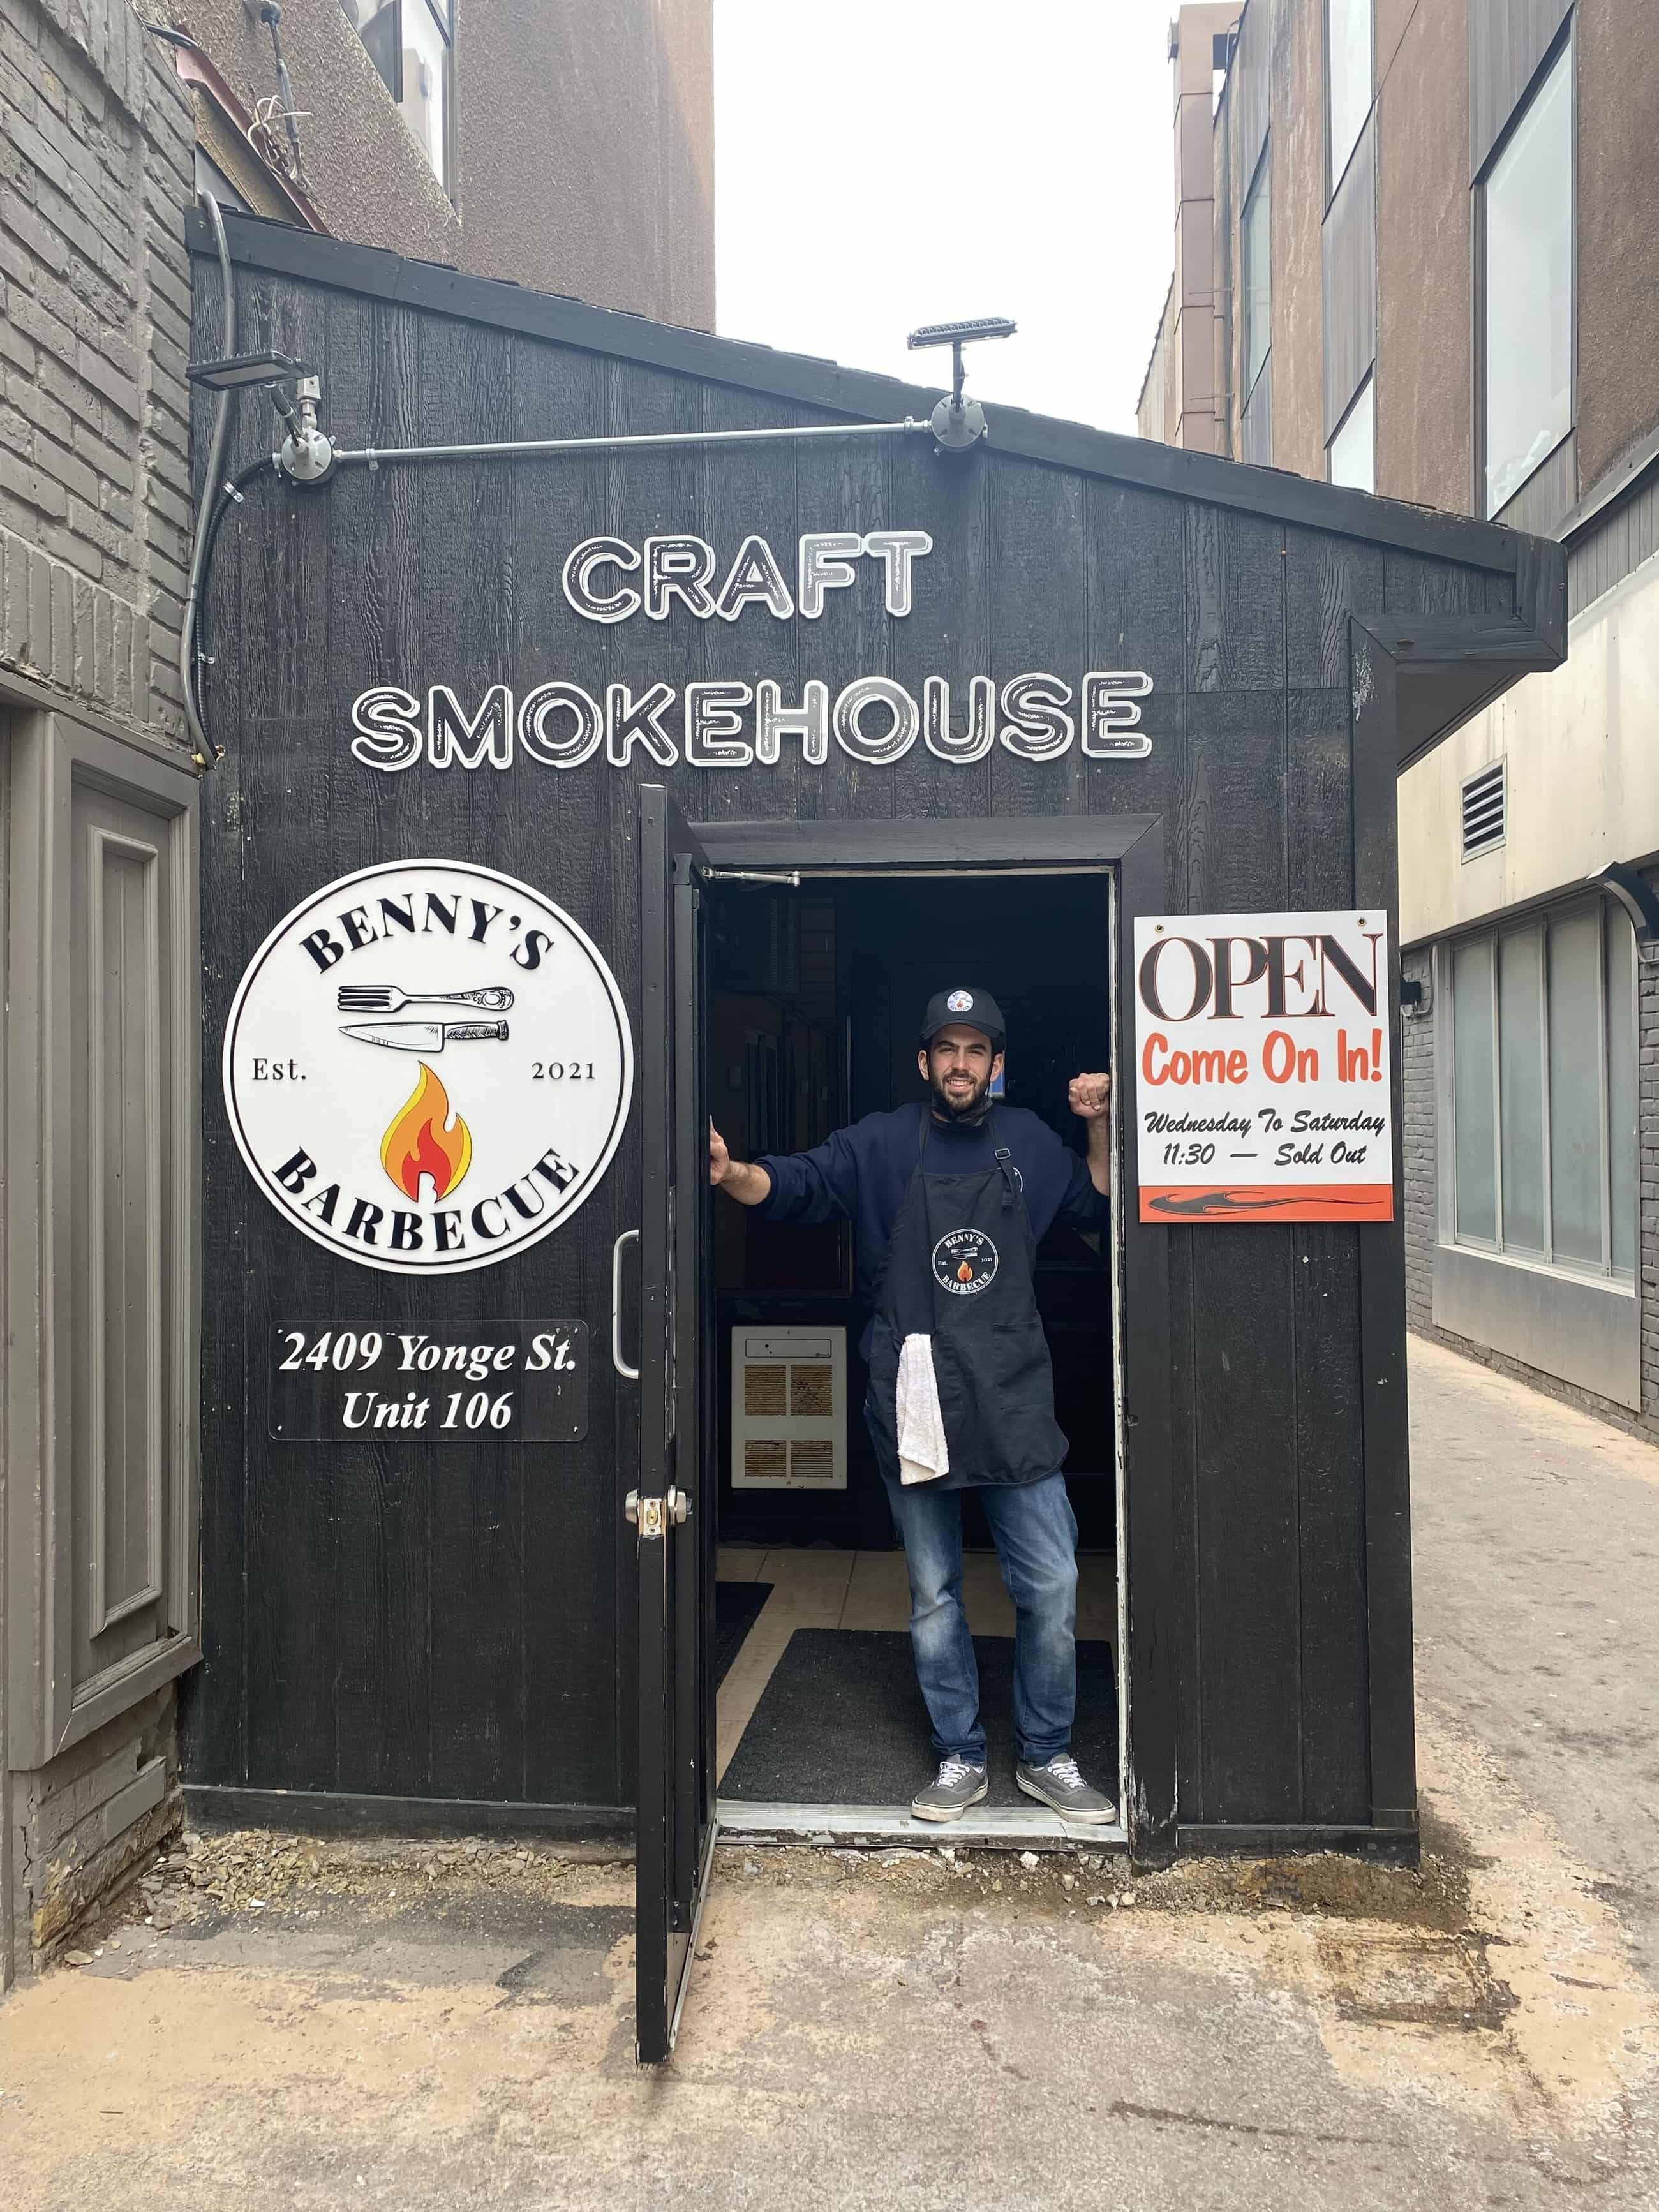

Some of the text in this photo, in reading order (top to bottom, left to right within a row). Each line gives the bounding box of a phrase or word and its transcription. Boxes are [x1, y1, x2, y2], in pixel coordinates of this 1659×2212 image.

[562, 530, 934, 623] CRAFT
[350, 671, 1154, 772] SMOKEHOUSE
[299, 892, 555, 974] BENNY'S
[1138, 932, 1385, 1022] OPEN
[253, 1058, 595, 1080] Est. 2021
[1142, 1028, 1383, 1085] Come On In!
[1144, 1108, 1386, 1139] Wednesday To Saturday
[1163, 1143, 1216, 1165] 11:30
[1274, 1143, 1323, 1166] Sold
[1330, 1141, 1368, 1165] Out
[272, 1146, 579, 1252] BARBECUE
[278, 1332, 576, 1381] 2409 Yonge St.
[342, 1391, 514, 1429] Unit 106
